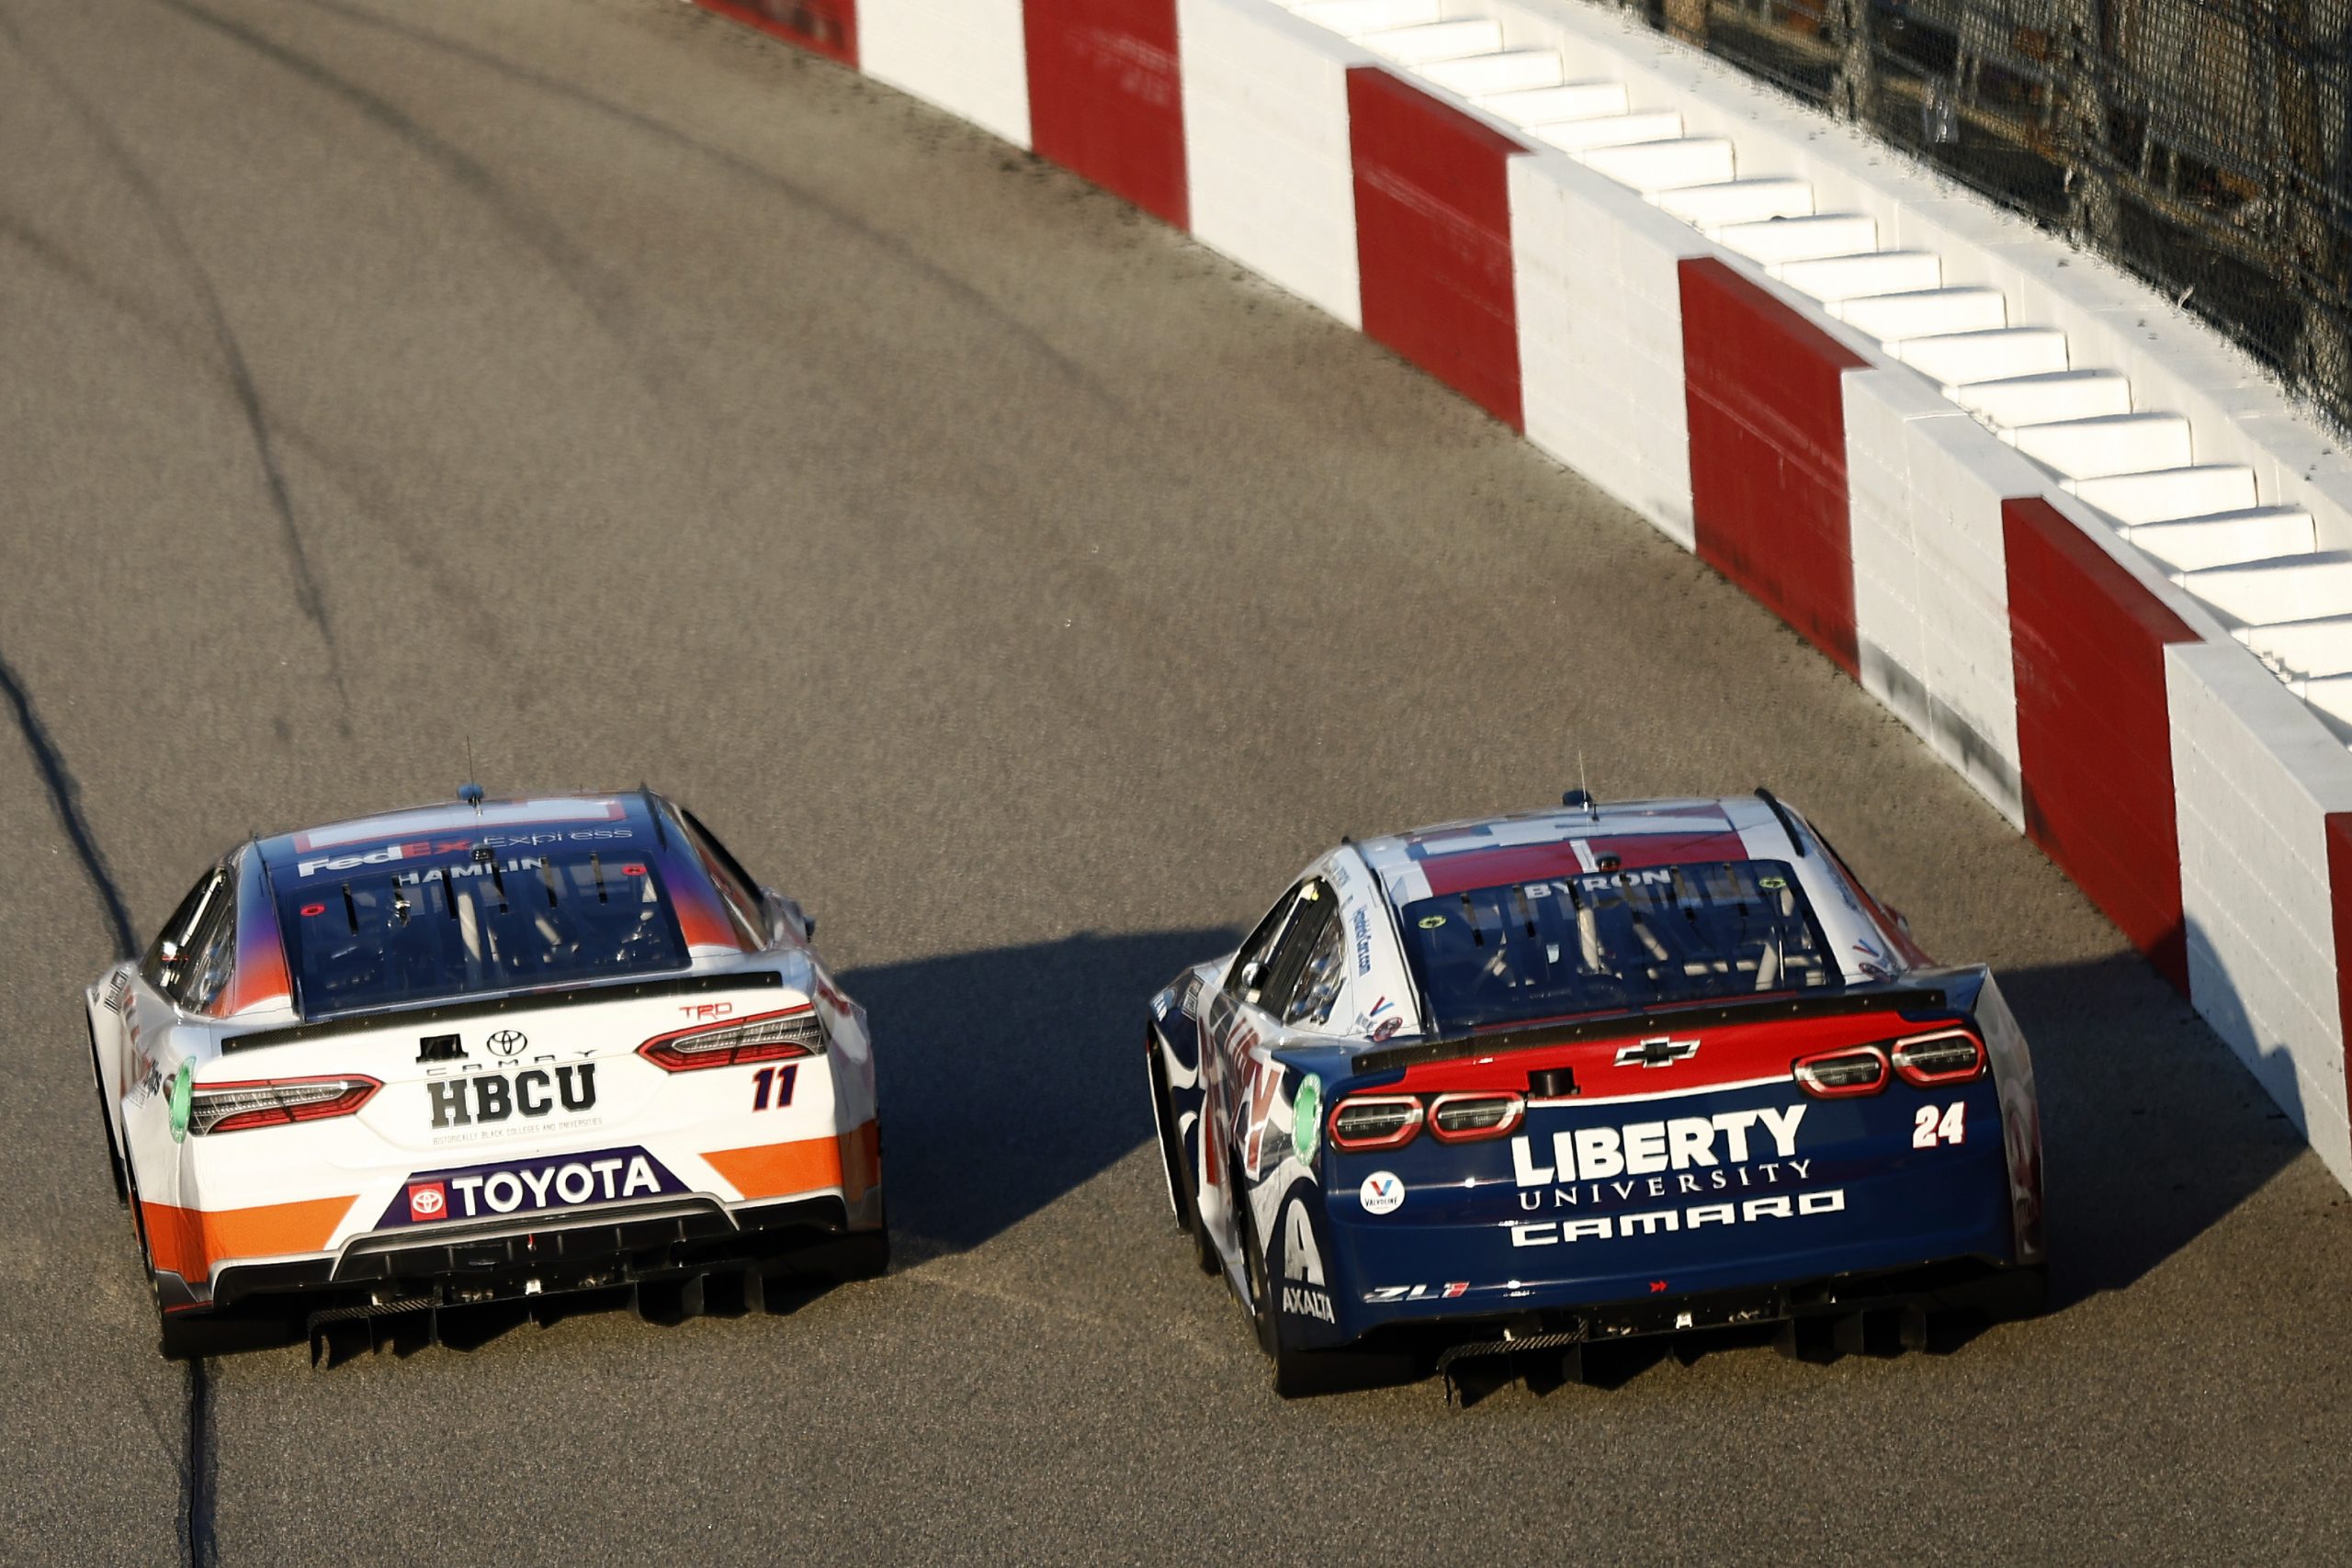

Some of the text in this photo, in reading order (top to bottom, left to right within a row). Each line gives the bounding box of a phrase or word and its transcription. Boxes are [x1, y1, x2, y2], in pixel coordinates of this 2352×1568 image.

[299, 829, 634, 877] FedEx Express
[398, 857, 544, 886] HAMLIN
[1524, 870, 1671, 900] BYRON
[679, 1002, 733, 1021] TRD
[426, 1063, 597, 1130] HBCU
[752, 1063, 799, 1112] 11
[481, 1129, 503, 1141] BLACK
[506, 1124, 540, 1137] COLLEGES
[542, 1122, 557, 1133] AND
[1511, 1103, 1807, 1188] LIBERTY
[1912, 1100, 1967, 1149] 24
[452, 1155, 662, 1217] TOYOTA
[1520, 1158, 1812, 1213] UNIVERSITY
[1511, 1189, 1846, 1248] CAMARO
[1282, 1286, 1336, 1325] AXALTA
[1363, 1280, 1471, 1304] ZL1
